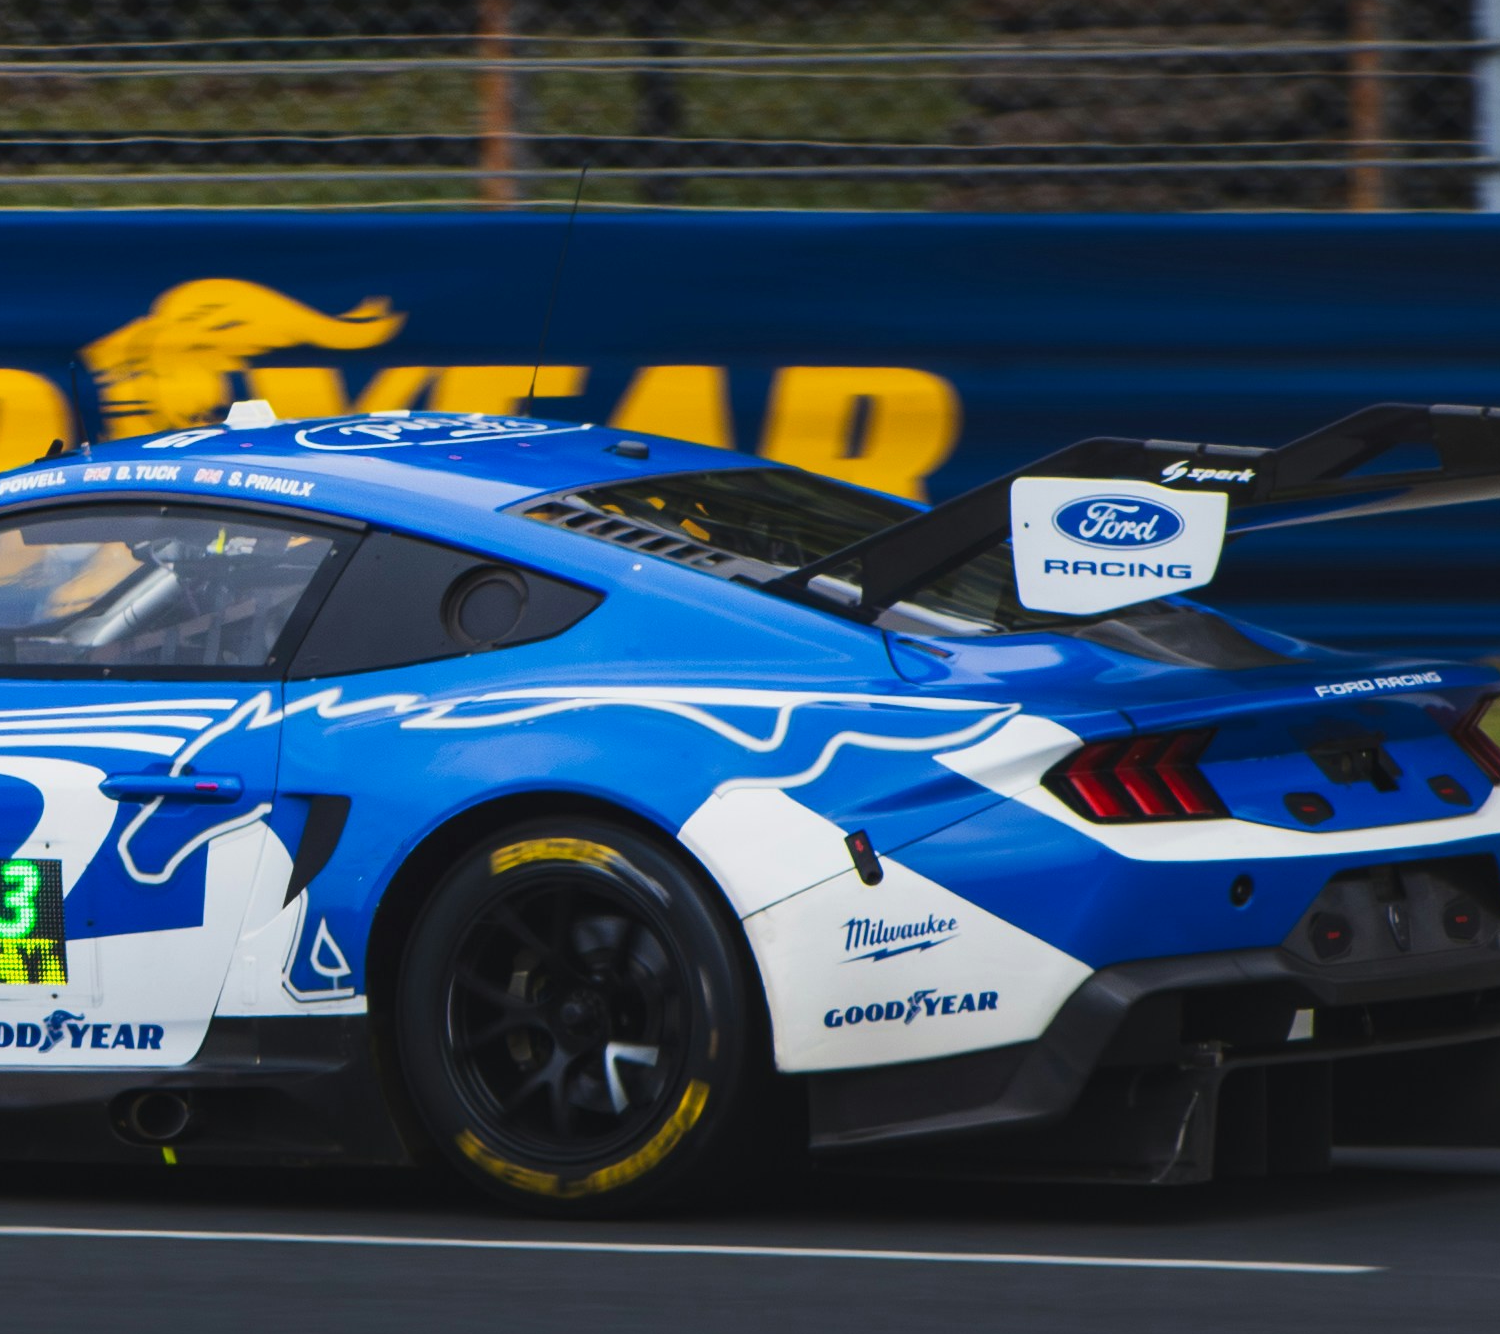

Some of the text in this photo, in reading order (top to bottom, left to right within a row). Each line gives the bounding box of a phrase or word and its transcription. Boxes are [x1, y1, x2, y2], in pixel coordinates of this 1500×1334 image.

[116, 465, 182, 481] B. TUCK
[228, 471, 315, 497] S. PRIAULX
[1188, 468, 1256, 483] spark
[1079, 502, 1160, 542] Ford
[1044, 559, 1192, 579] RACING
[1314, 671, 1443, 698] FORD RACING
[840, 912, 960, 953] Milwaukee
[824, 990, 999, 1029] GOODYEAR
